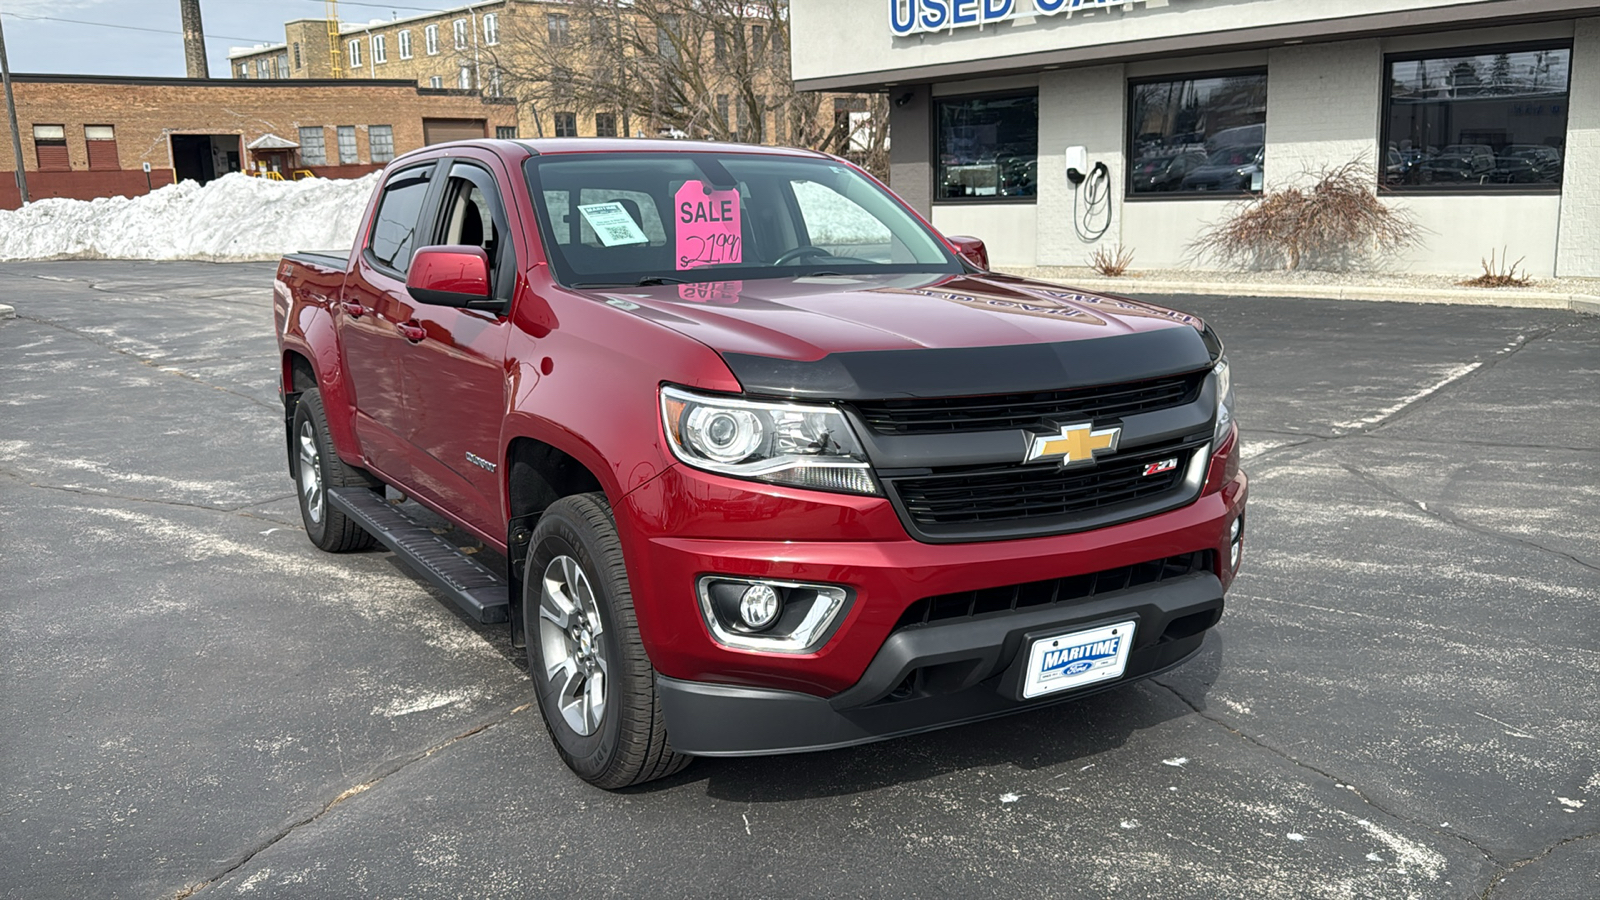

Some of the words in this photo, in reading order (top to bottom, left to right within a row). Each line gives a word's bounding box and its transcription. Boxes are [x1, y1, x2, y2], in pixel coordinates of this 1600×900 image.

[681, 200, 733, 224] SALE
[1142, 458, 1178, 477] Z71
[1043, 638, 1119, 671] MARITIME
[1067, 663, 1089, 675] Ford
